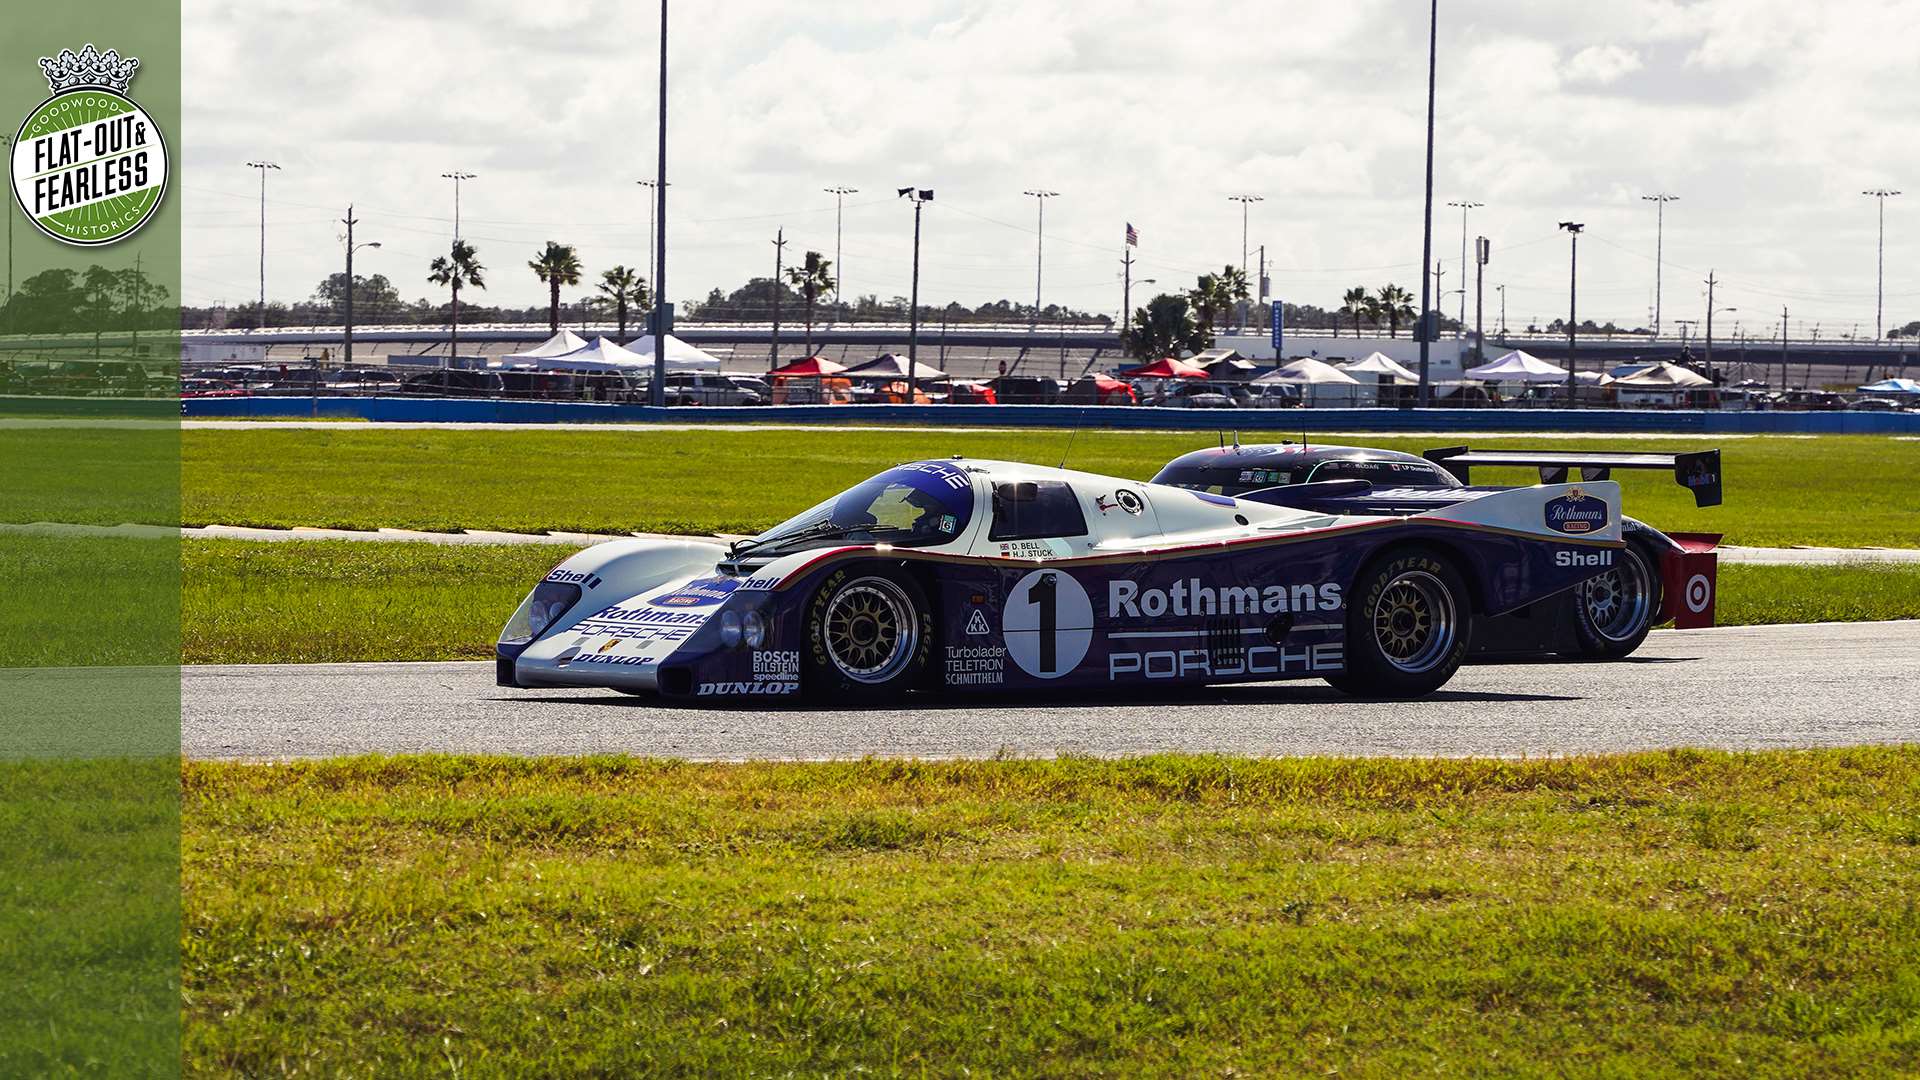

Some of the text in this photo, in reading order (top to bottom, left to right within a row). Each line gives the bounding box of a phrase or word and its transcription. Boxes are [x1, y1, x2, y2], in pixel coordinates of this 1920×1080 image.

[896, 463, 970, 490] SCHE
[1551, 504, 1602, 520] Rothmans
[1021, 542, 1040, 550] BELL
[1028, 549, 1053, 557] STUCK
[1556, 550, 1612, 566] Shell
[547, 569, 602, 590] Shell
[741, 577, 780, 589] hell
[1109, 578, 1342, 618] Rothmans
[1028, 572, 1057, 673] 1
[570, 623, 693, 641] PORSCHE
[753, 651, 799, 663] BOSCH
[945, 645, 1006, 659] Turbolader
[573, 653, 655, 666] DUNLOP
[945, 659, 1004, 672] TELETRON
[1110, 642, 1343, 681] PORSCHE
[753, 662, 799, 672] BILSTEIN
[753, 672, 799, 681] speedline
[945, 672, 1004, 685] SCHMITTHELM
[697, 681, 800, 696] DUNLOP
